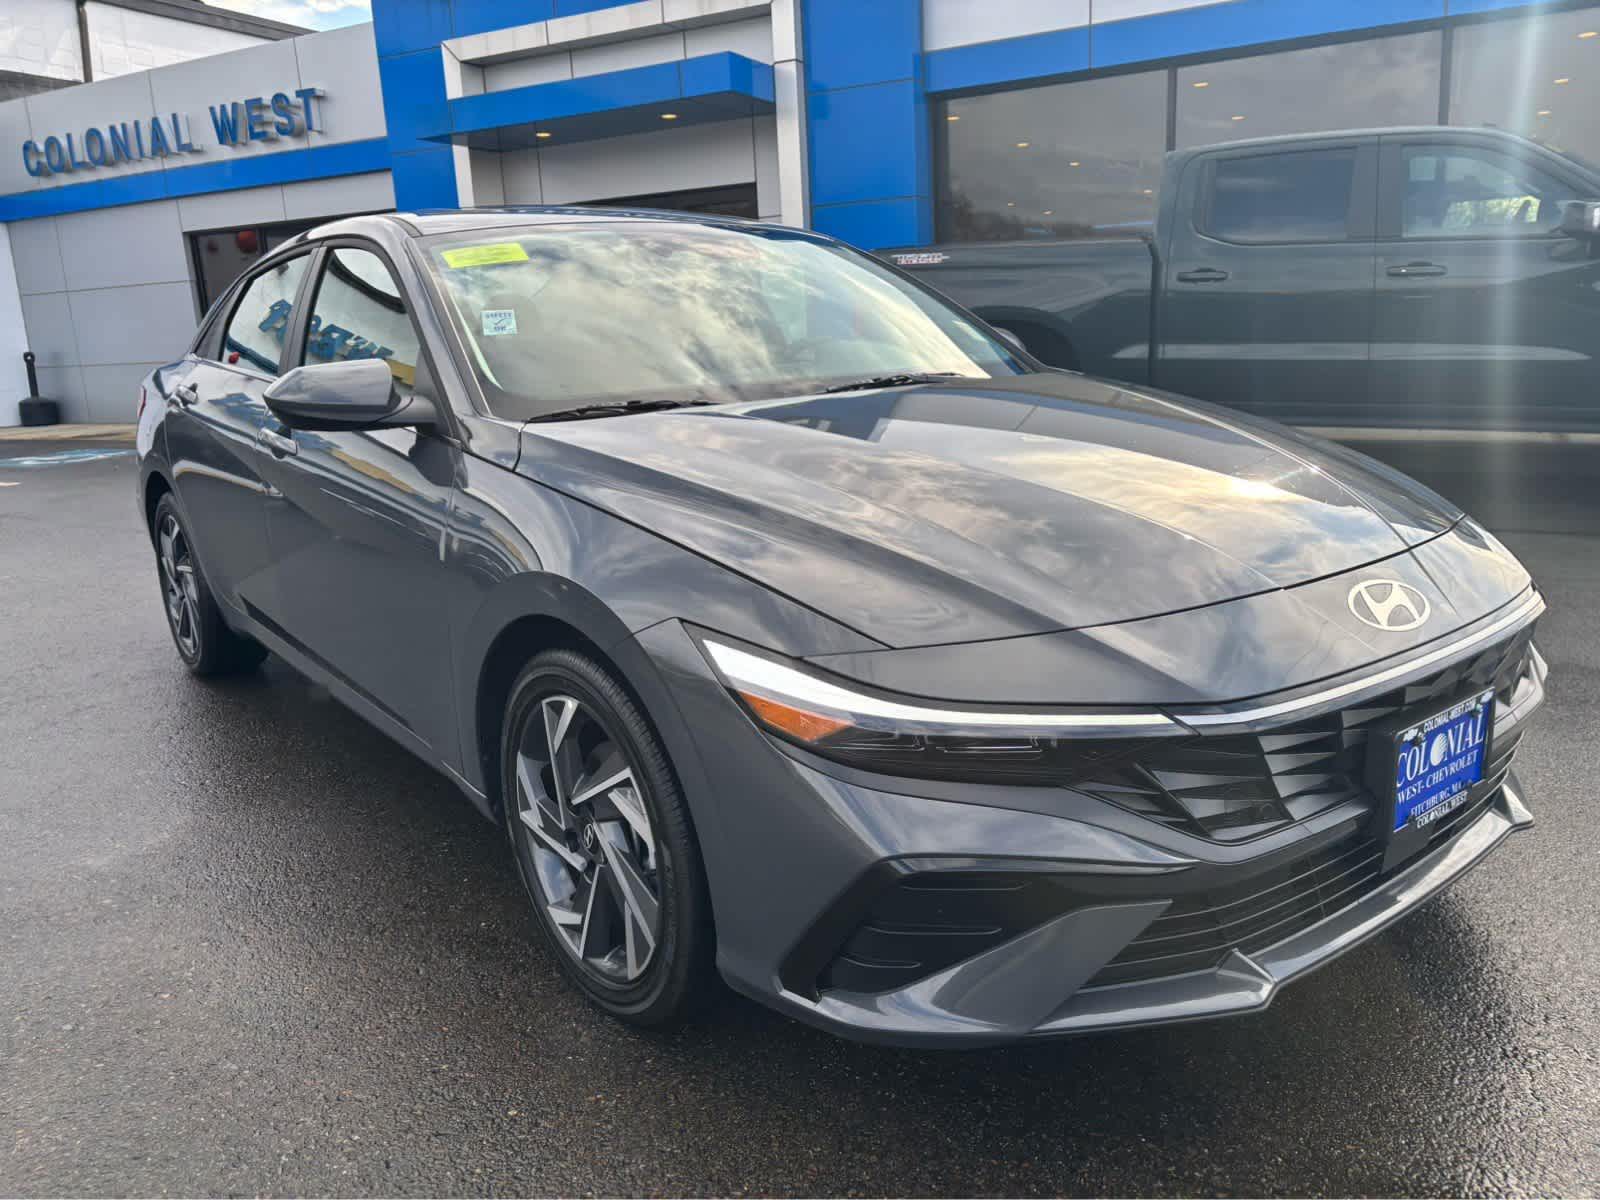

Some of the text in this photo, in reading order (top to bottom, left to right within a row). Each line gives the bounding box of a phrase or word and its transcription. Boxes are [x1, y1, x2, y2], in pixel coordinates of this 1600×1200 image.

[22, 87, 325, 177] COLONIAL WEST
[1396, 713, 1484, 787] COLONIAL
